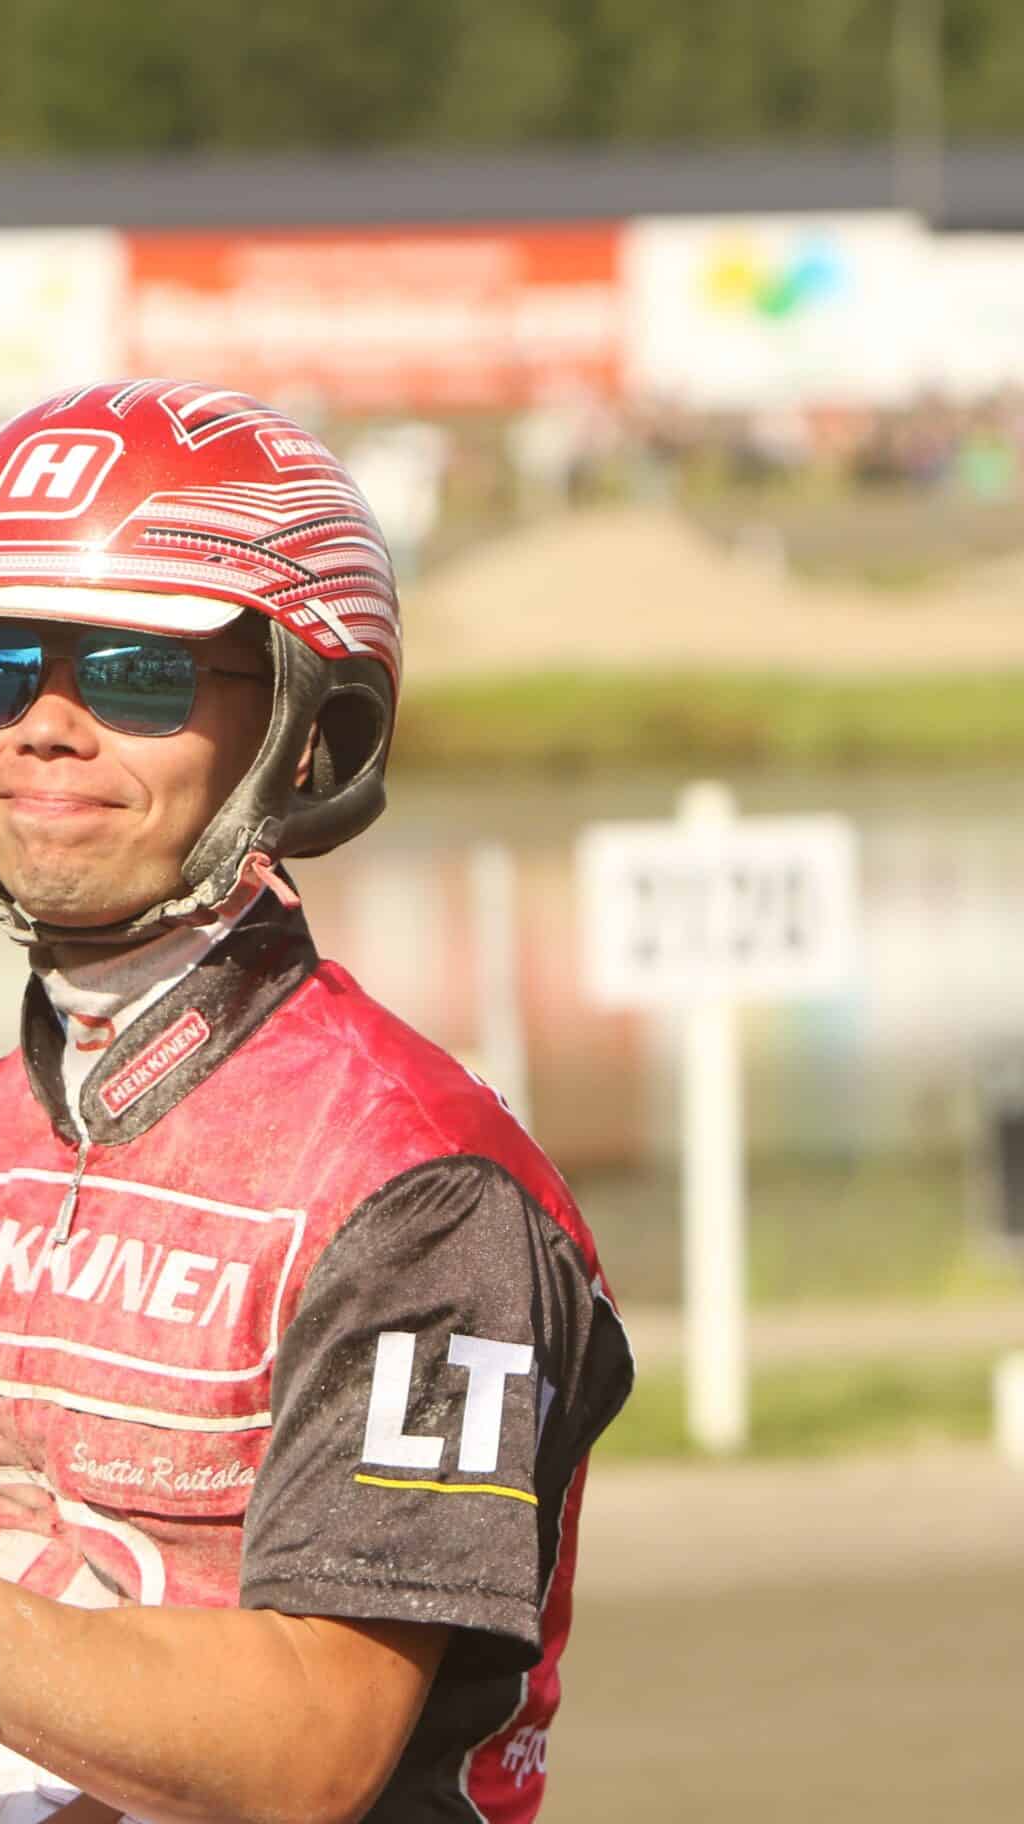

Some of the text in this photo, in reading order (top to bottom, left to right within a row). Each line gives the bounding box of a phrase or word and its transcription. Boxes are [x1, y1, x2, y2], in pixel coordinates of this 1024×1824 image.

[8, 443, 95, 499] H
[110, 1022, 201, 1104] HEIKKINEN
[151, 1456, 257, 1493] Raitala
